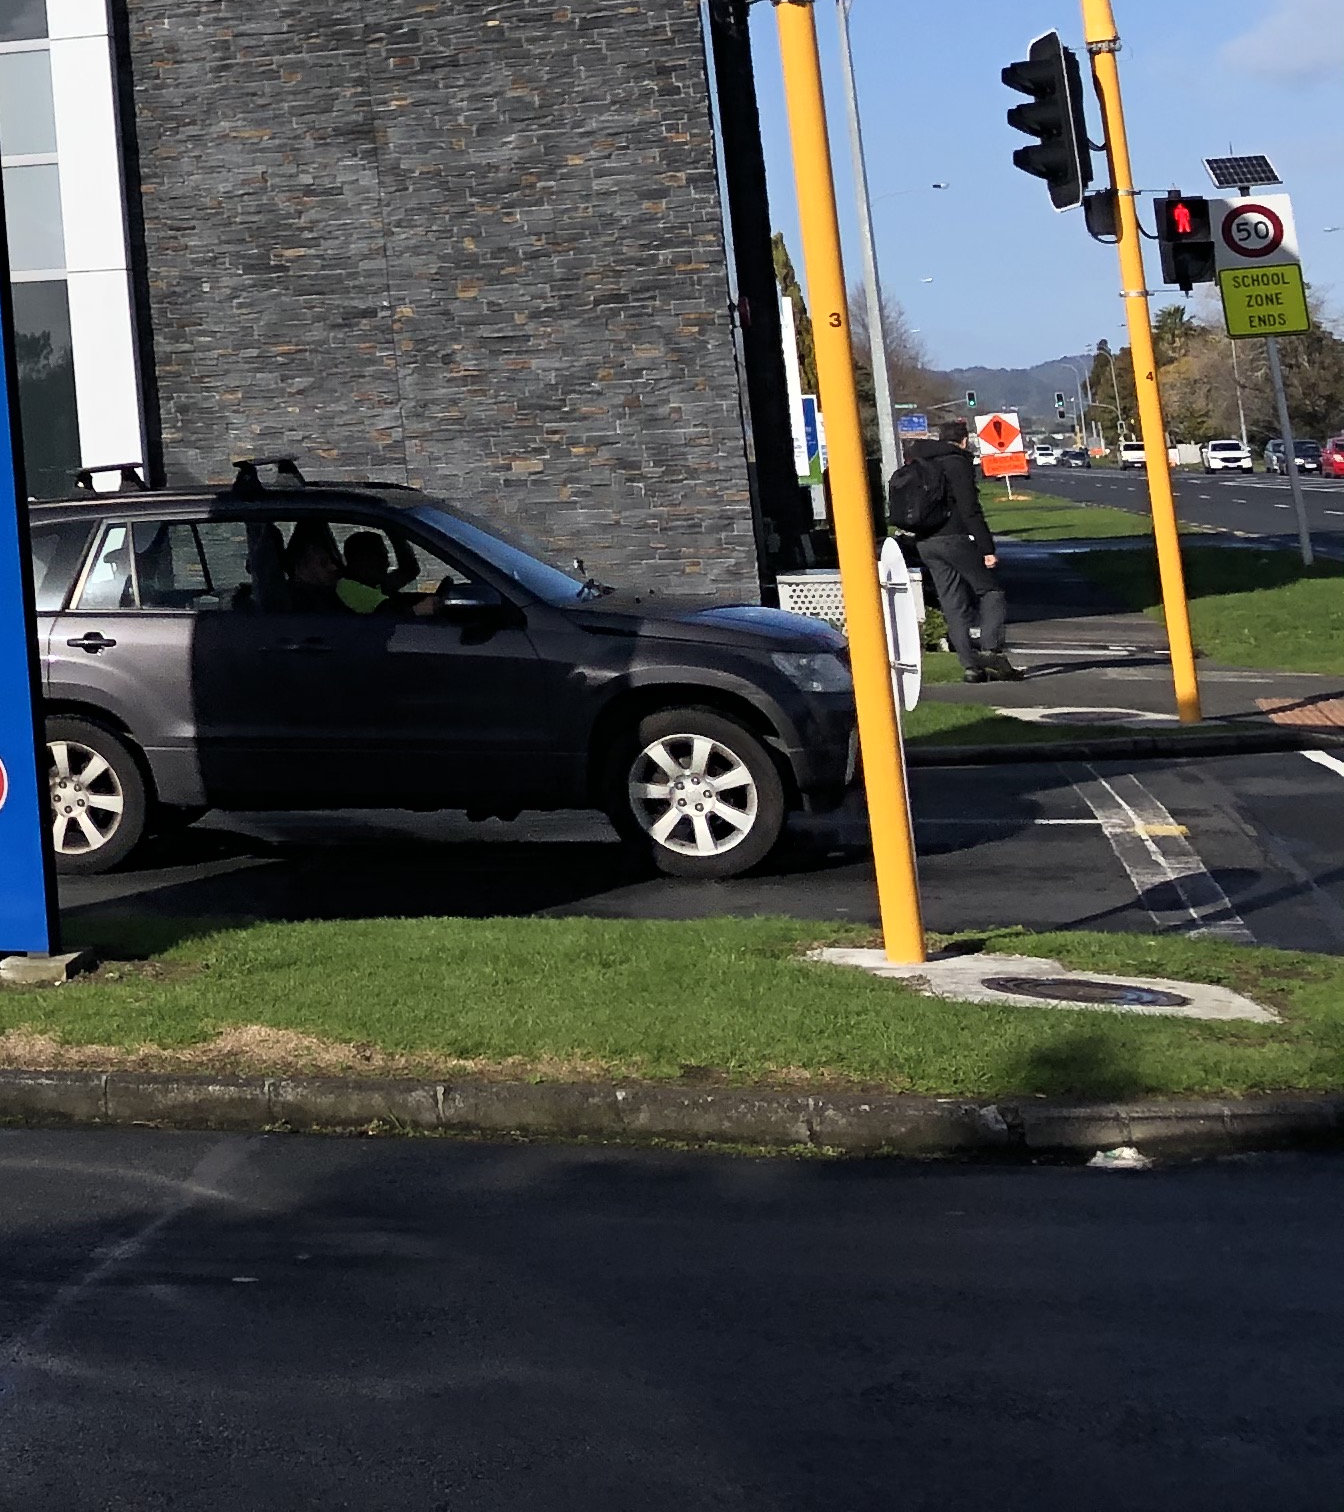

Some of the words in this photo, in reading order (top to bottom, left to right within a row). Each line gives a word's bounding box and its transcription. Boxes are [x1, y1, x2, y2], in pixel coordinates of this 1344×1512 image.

[1236, 221, 1269, 241] 50
[1232, 272, 1290, 288] SCHOOL
[1246, 292, 1283, 308] ZONE
[829, 312, 842, 328] 3
[1248, 313, 1286, 328] ENDS
[1145, 371, 1154, 382] 4
